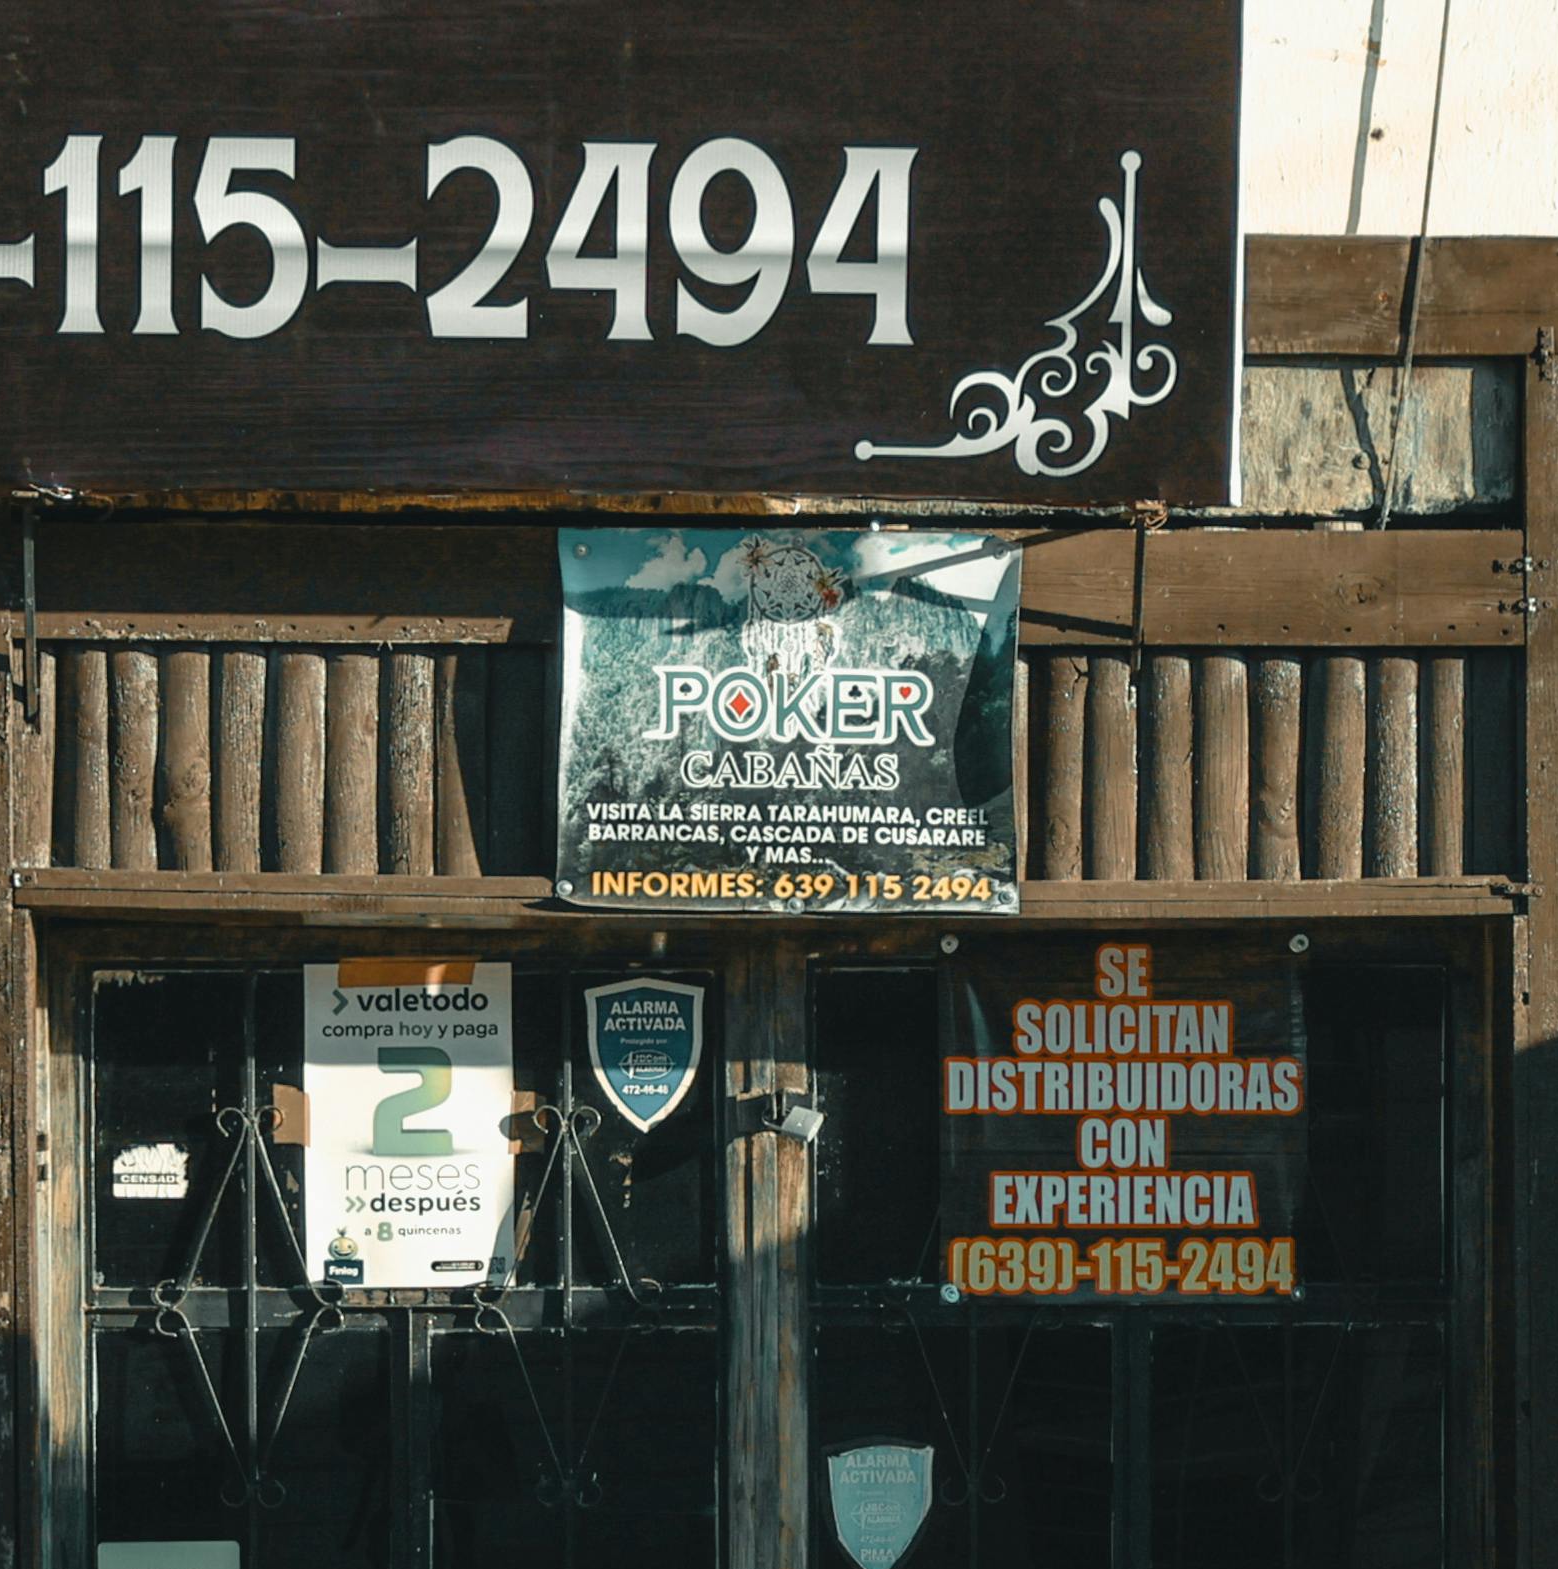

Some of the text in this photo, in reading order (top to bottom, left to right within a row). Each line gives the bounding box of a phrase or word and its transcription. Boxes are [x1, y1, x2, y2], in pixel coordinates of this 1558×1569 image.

[646, 667, 935, 745] POKER
[681, 744, 899, 790] CABAÑAS
[586, 803, 988, 828] VISITA LA SIERRA TARAHUMARA, CREEL
[588, 824, 986, 847] BARRANCAS, CASCADA DE CUSARARE
[746, 847, 831, 864] Y MAS...
[591, 871, 992, 901] INFORMES: 639 115 2494
[1098, 947, 1148, 998] SE
[356, 986, 489, 1012] valetodo
[611, 1001, 679, 1015] ALARMA
[322, 1021, 498, 1039] compra hoy y paga
[604, 1017, 686, 1031] ACTIVADA
[1016, 1004, 1229, 1054] SOLICITAN
[946, 1061, 1300, 1112] DISTRIBUIDORAS
[373, 1046, 453, 1157] 2
[1080, 1118, 1166, 1168] CON
[345, 1164, 480, 1191] meses
[370, 1190, 481, 1215] después
[992, 1175, 1255, 1225] EXPERIENCIA
[364, 1222, 461, 1241] a 8 quincenas
[951, 1241, 1295, 1292] (639)-115-2494
[845, 1454, 910, 1468] ALARMA
[840, 1470, 916, 1483] ACTIVADA
